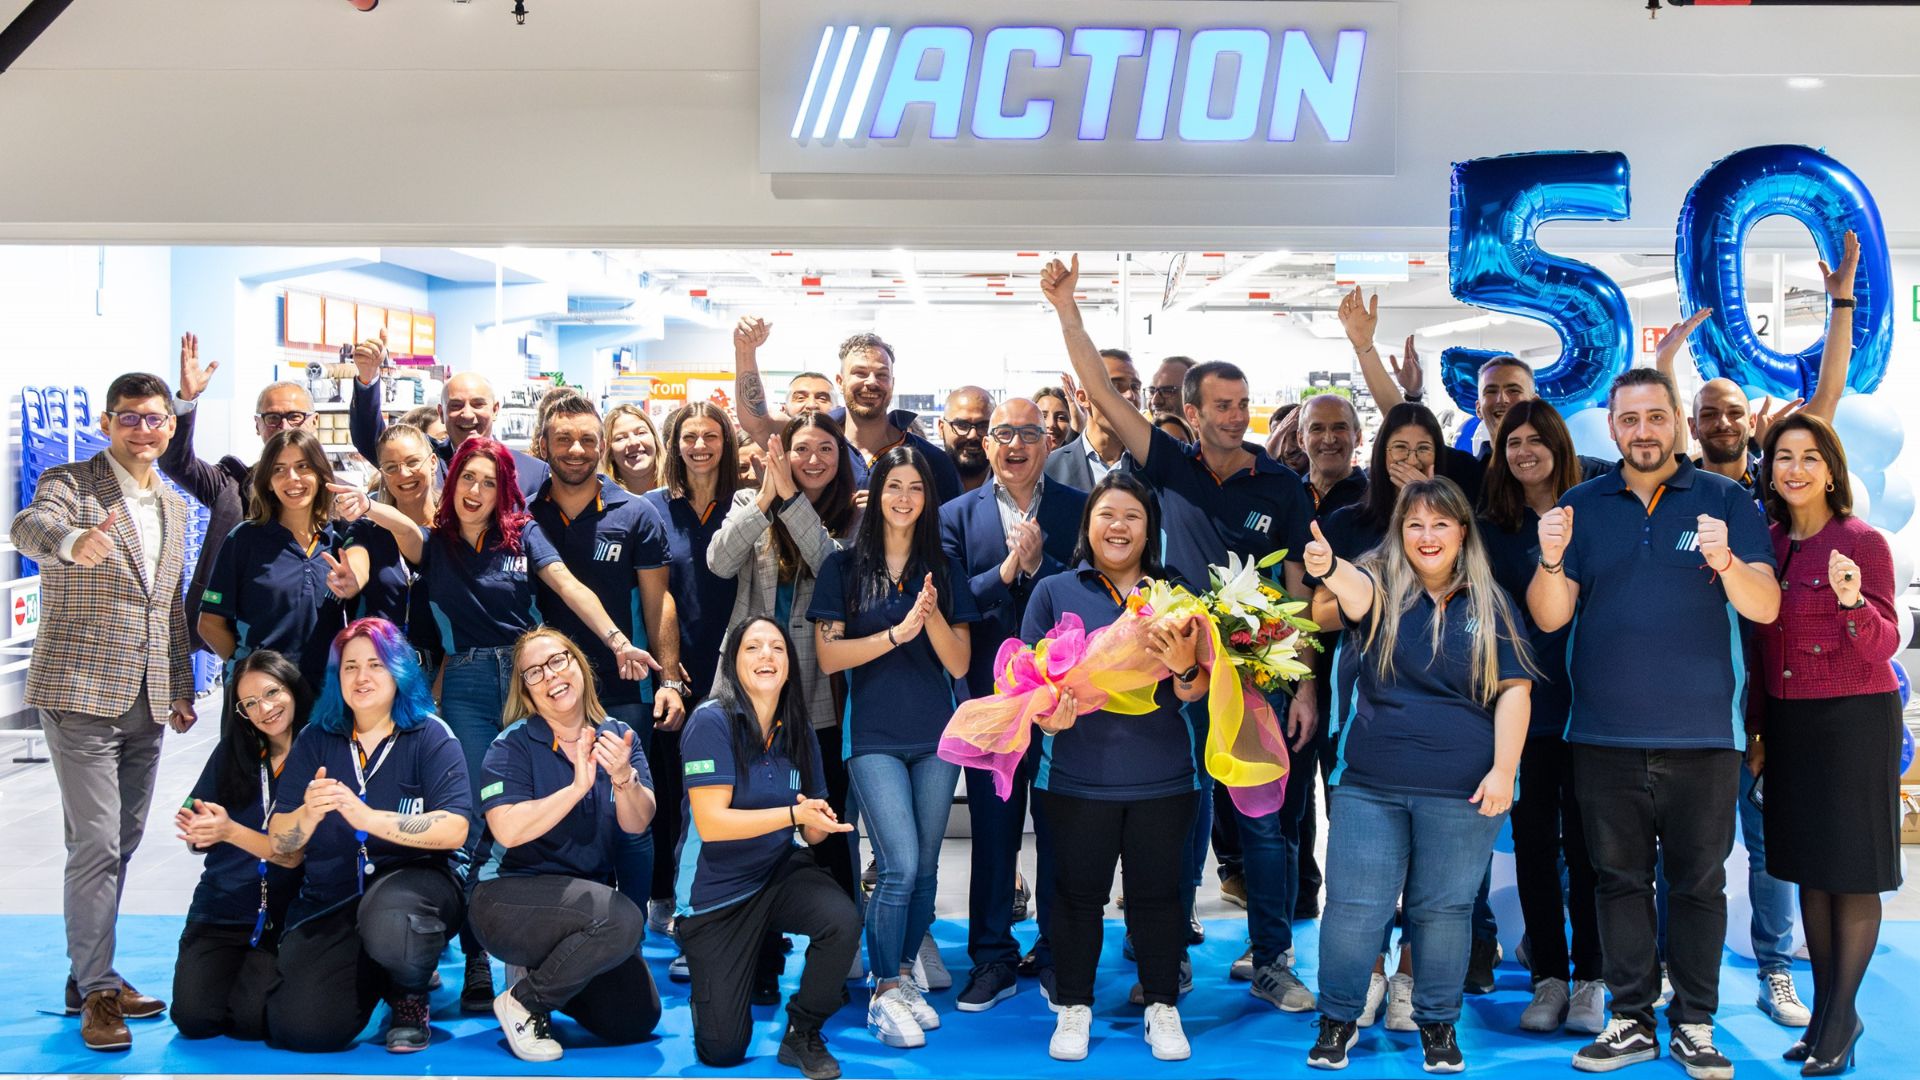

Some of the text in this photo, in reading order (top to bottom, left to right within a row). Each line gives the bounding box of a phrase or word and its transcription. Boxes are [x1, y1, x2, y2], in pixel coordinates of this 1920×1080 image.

[869, 26, 1368, 142] ACTION
[1440, 143, 1895, 416] 50
[1143, 313, 1152, 335] 1
[1757, 314, 1769, 336] 2
